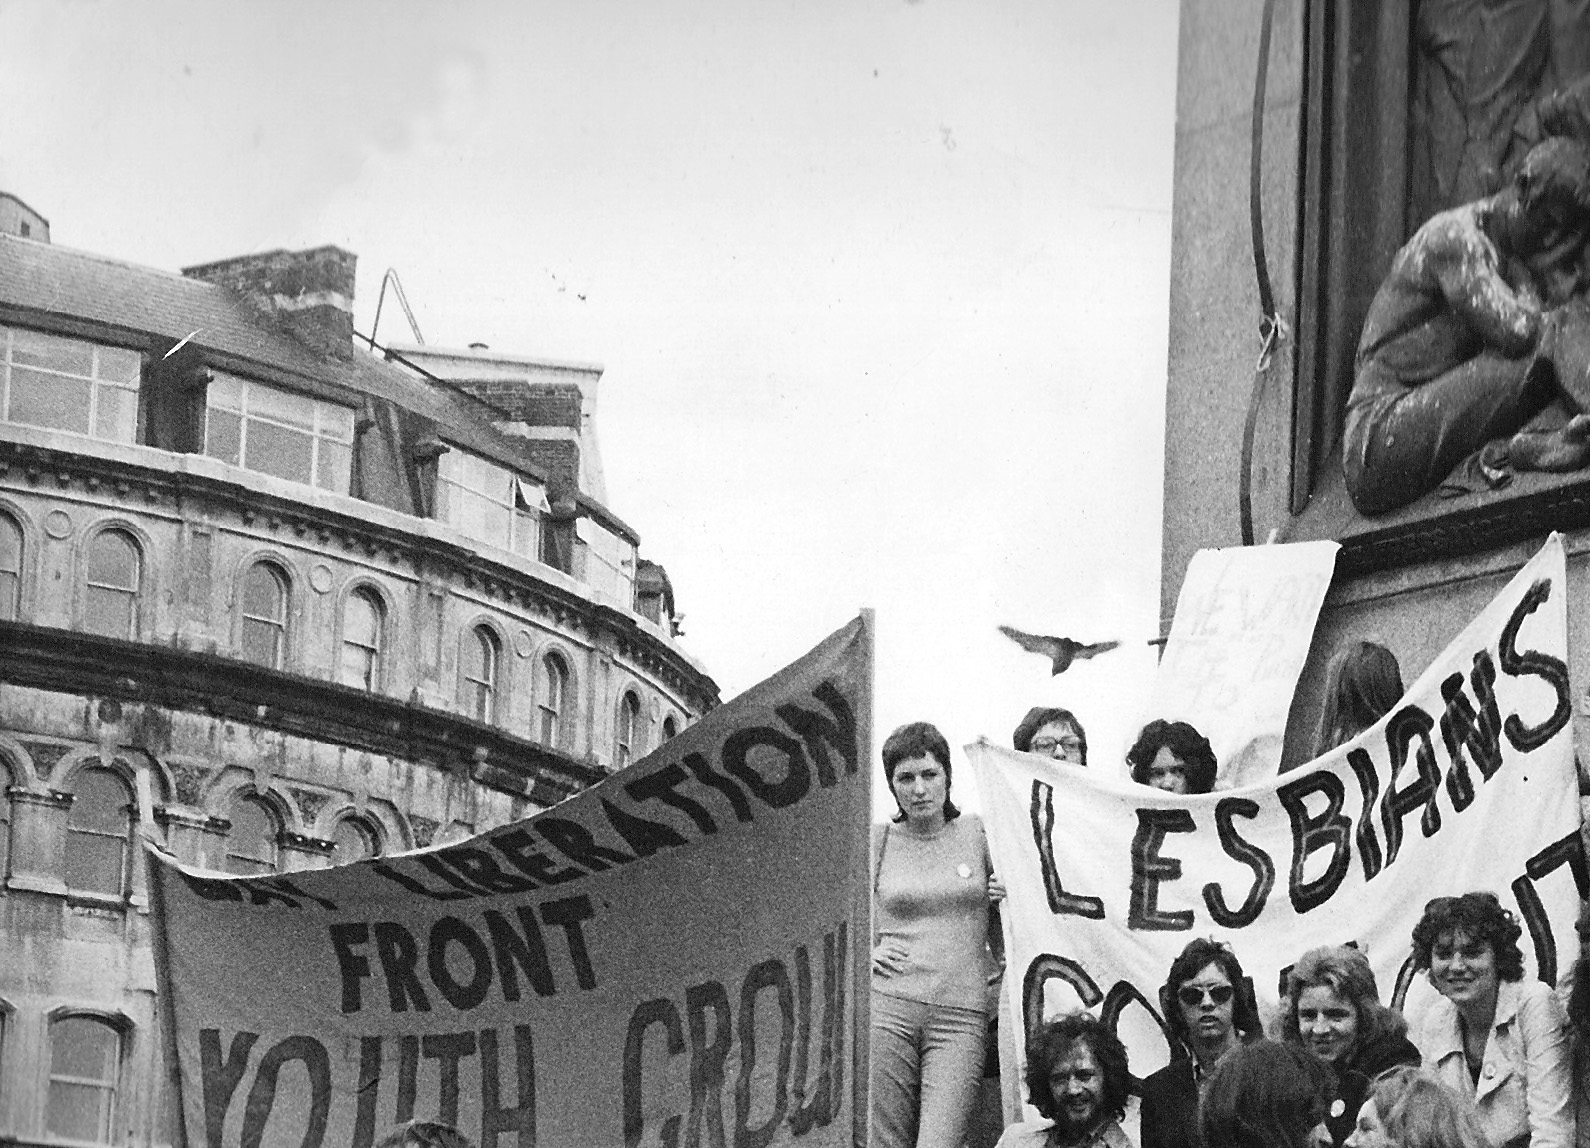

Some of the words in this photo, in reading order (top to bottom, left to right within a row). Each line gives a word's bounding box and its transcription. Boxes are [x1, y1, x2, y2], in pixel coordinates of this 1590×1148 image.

[370, 681, 858, 901] LIBERATION
[1030, 577, 1572, 932] LESBIANS
[329, 894, 598, 1014] FRONT
